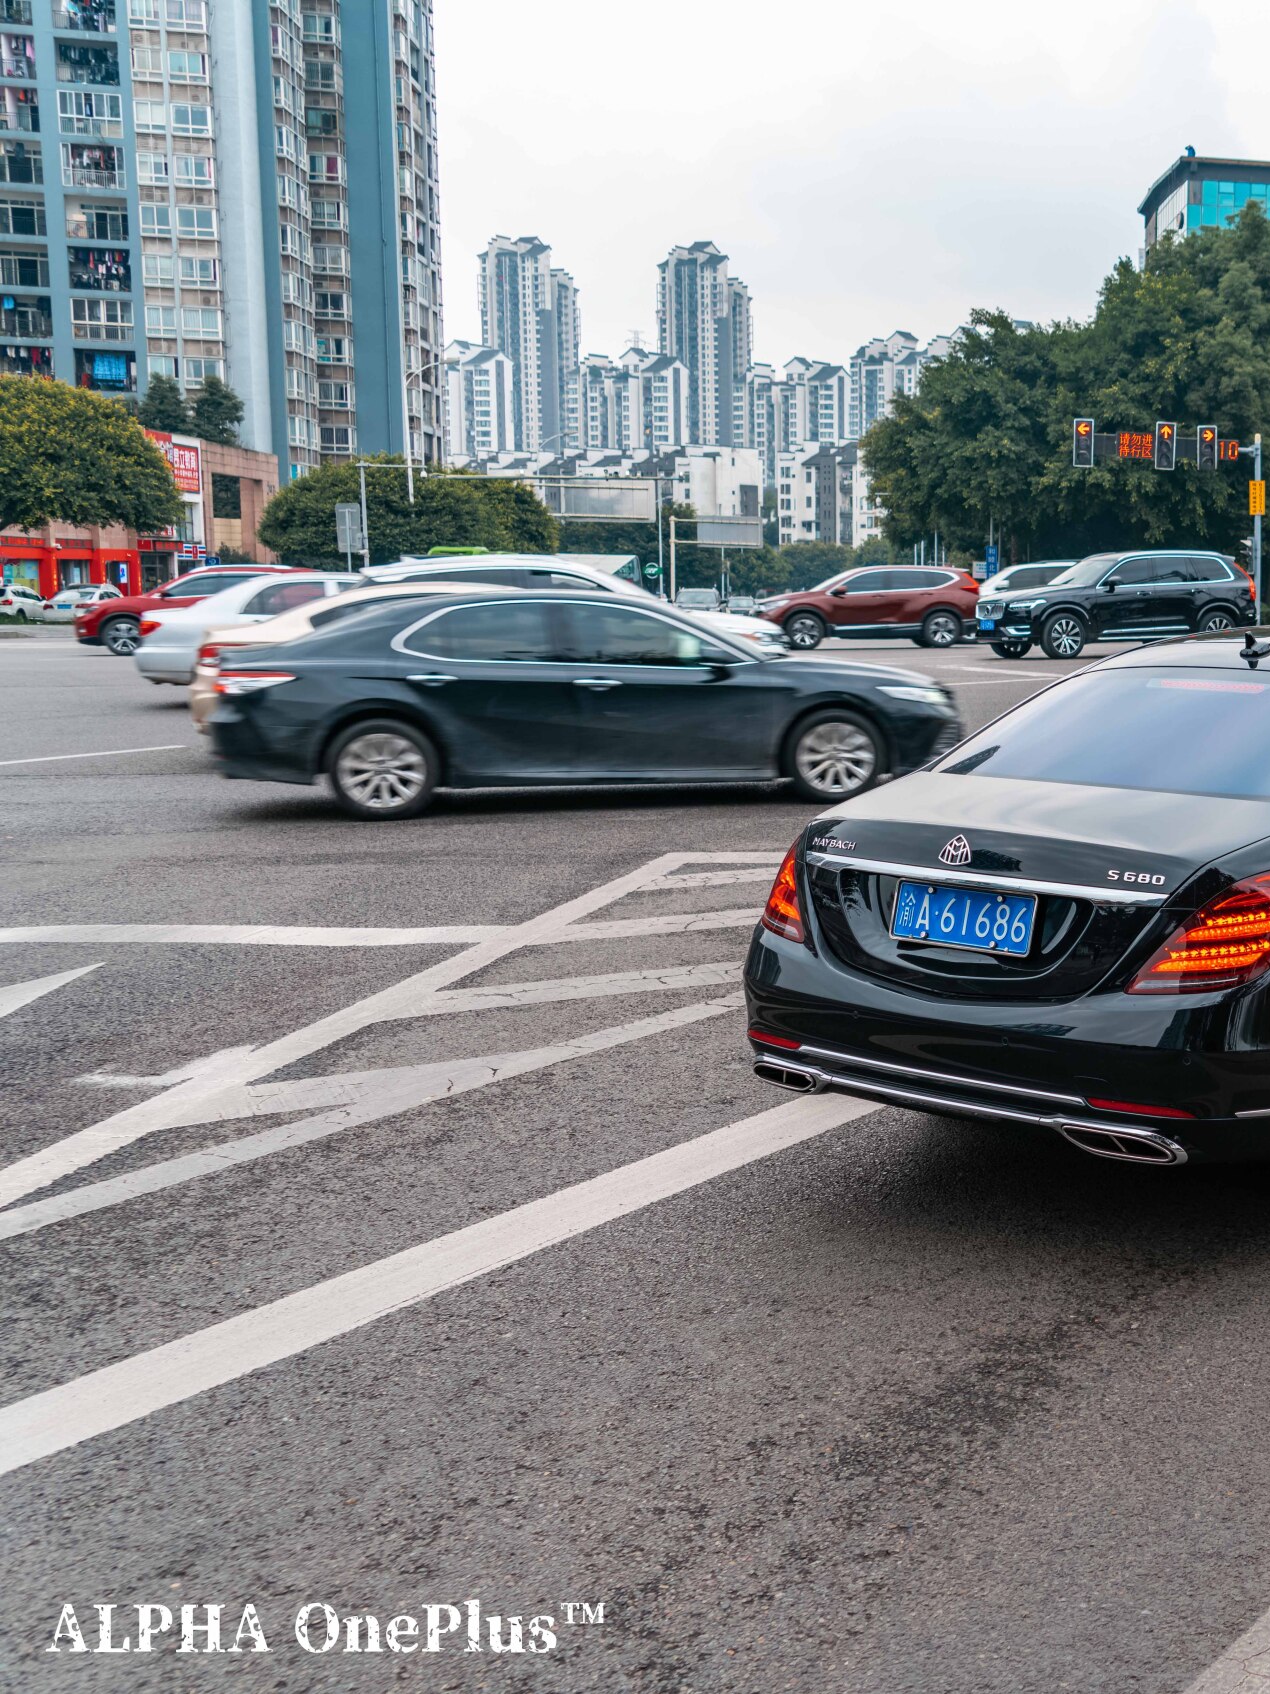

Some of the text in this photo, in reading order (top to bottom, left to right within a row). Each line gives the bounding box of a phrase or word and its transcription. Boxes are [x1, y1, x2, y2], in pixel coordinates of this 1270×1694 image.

[1119, 432, 1152, 446] 请勿进
[1119, 445, 1152, 458] 待行区
[1219, 440, 1239, 460] 10
[812, 837, 856, 850] MAYBACH
[1107, 869, 1165, 885] S 680
